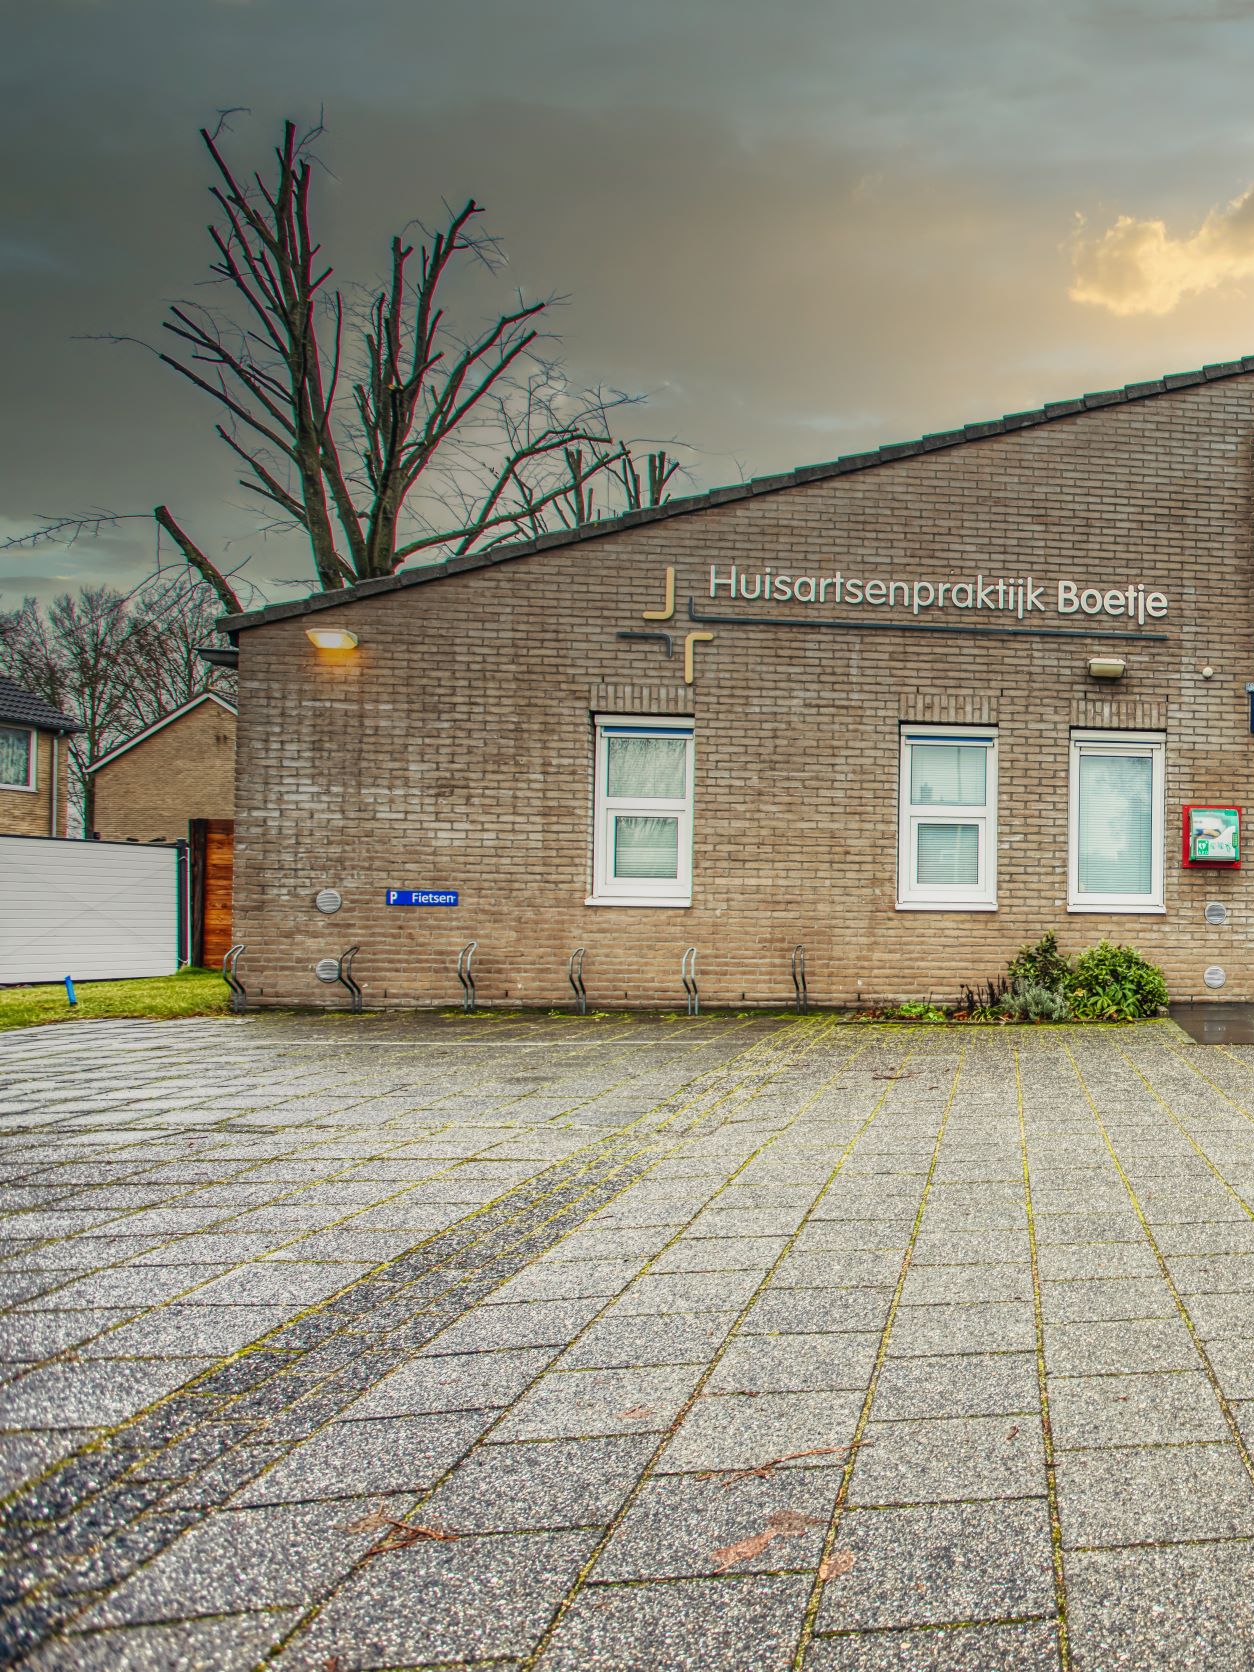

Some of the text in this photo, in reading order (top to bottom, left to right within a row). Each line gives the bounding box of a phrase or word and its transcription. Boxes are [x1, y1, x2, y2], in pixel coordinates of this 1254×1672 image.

[709, 564, 1169, 625] Huisartsenpraktijk Boetje
[390, 891, 454, 904] P Fietsen
